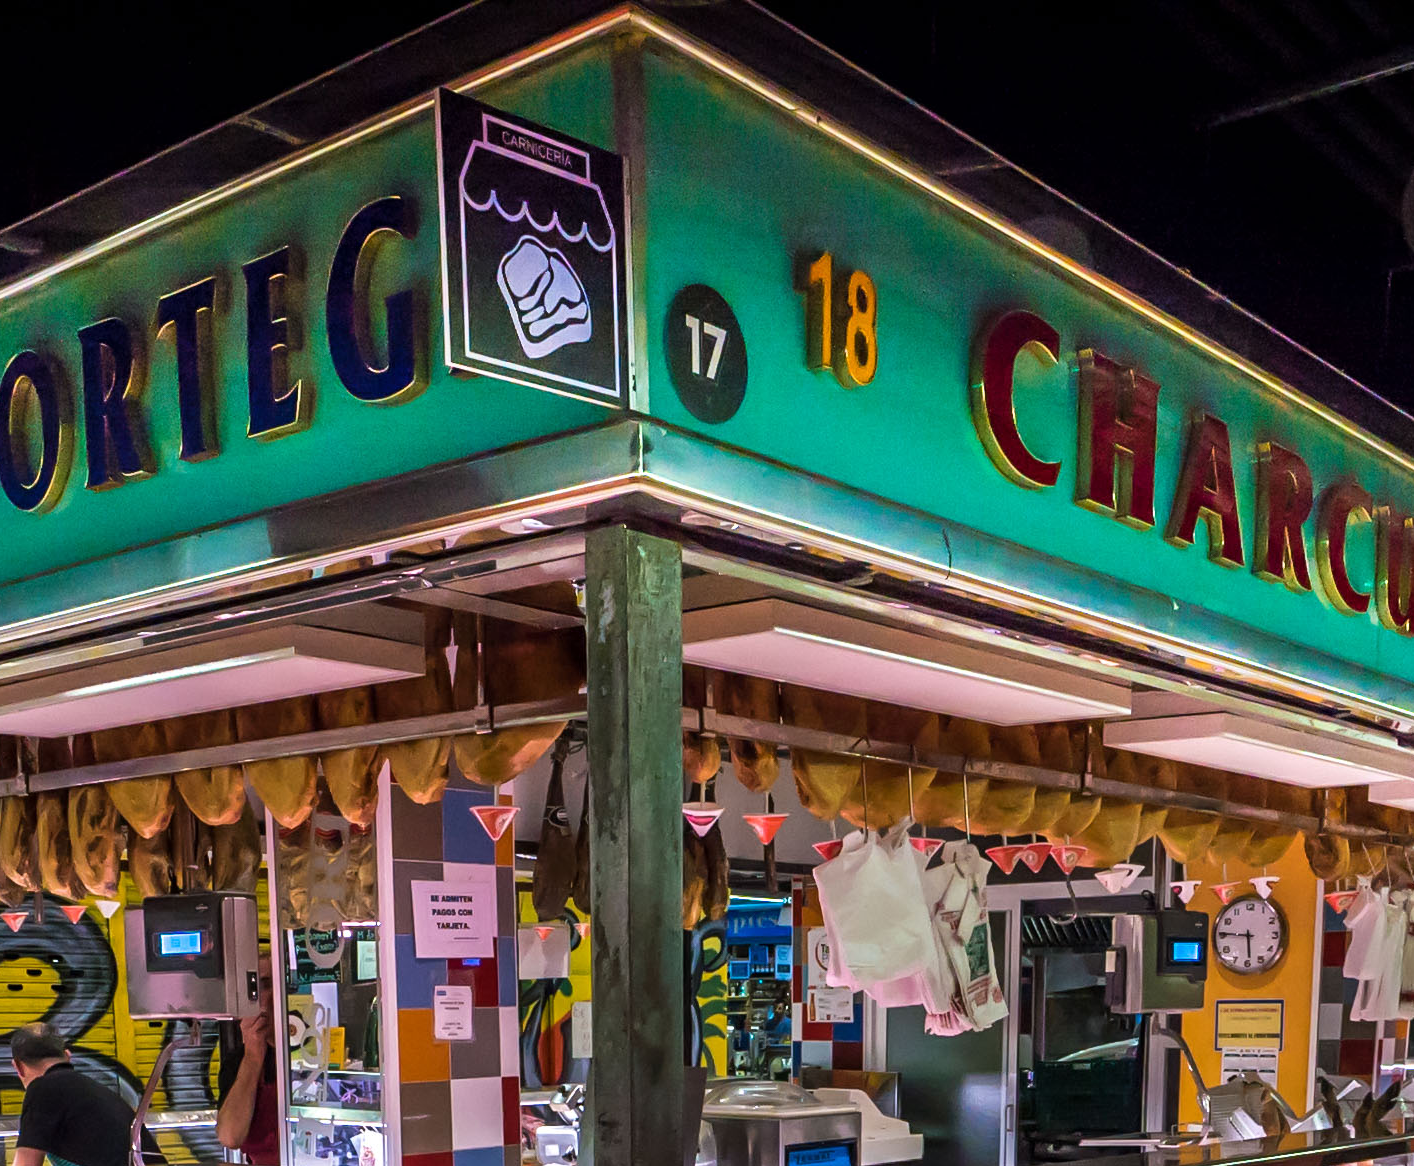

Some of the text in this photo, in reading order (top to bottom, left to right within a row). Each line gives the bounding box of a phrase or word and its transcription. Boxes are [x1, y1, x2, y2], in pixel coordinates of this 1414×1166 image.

[501, 130, 573, 169] CARNICERÍA
[805, 250, 879, 388] 18
[684, 313, 729, 380] 17
[431, 908, 473, 916] PAGOS CON
[441, 895, 473, 903] ADMITEN
